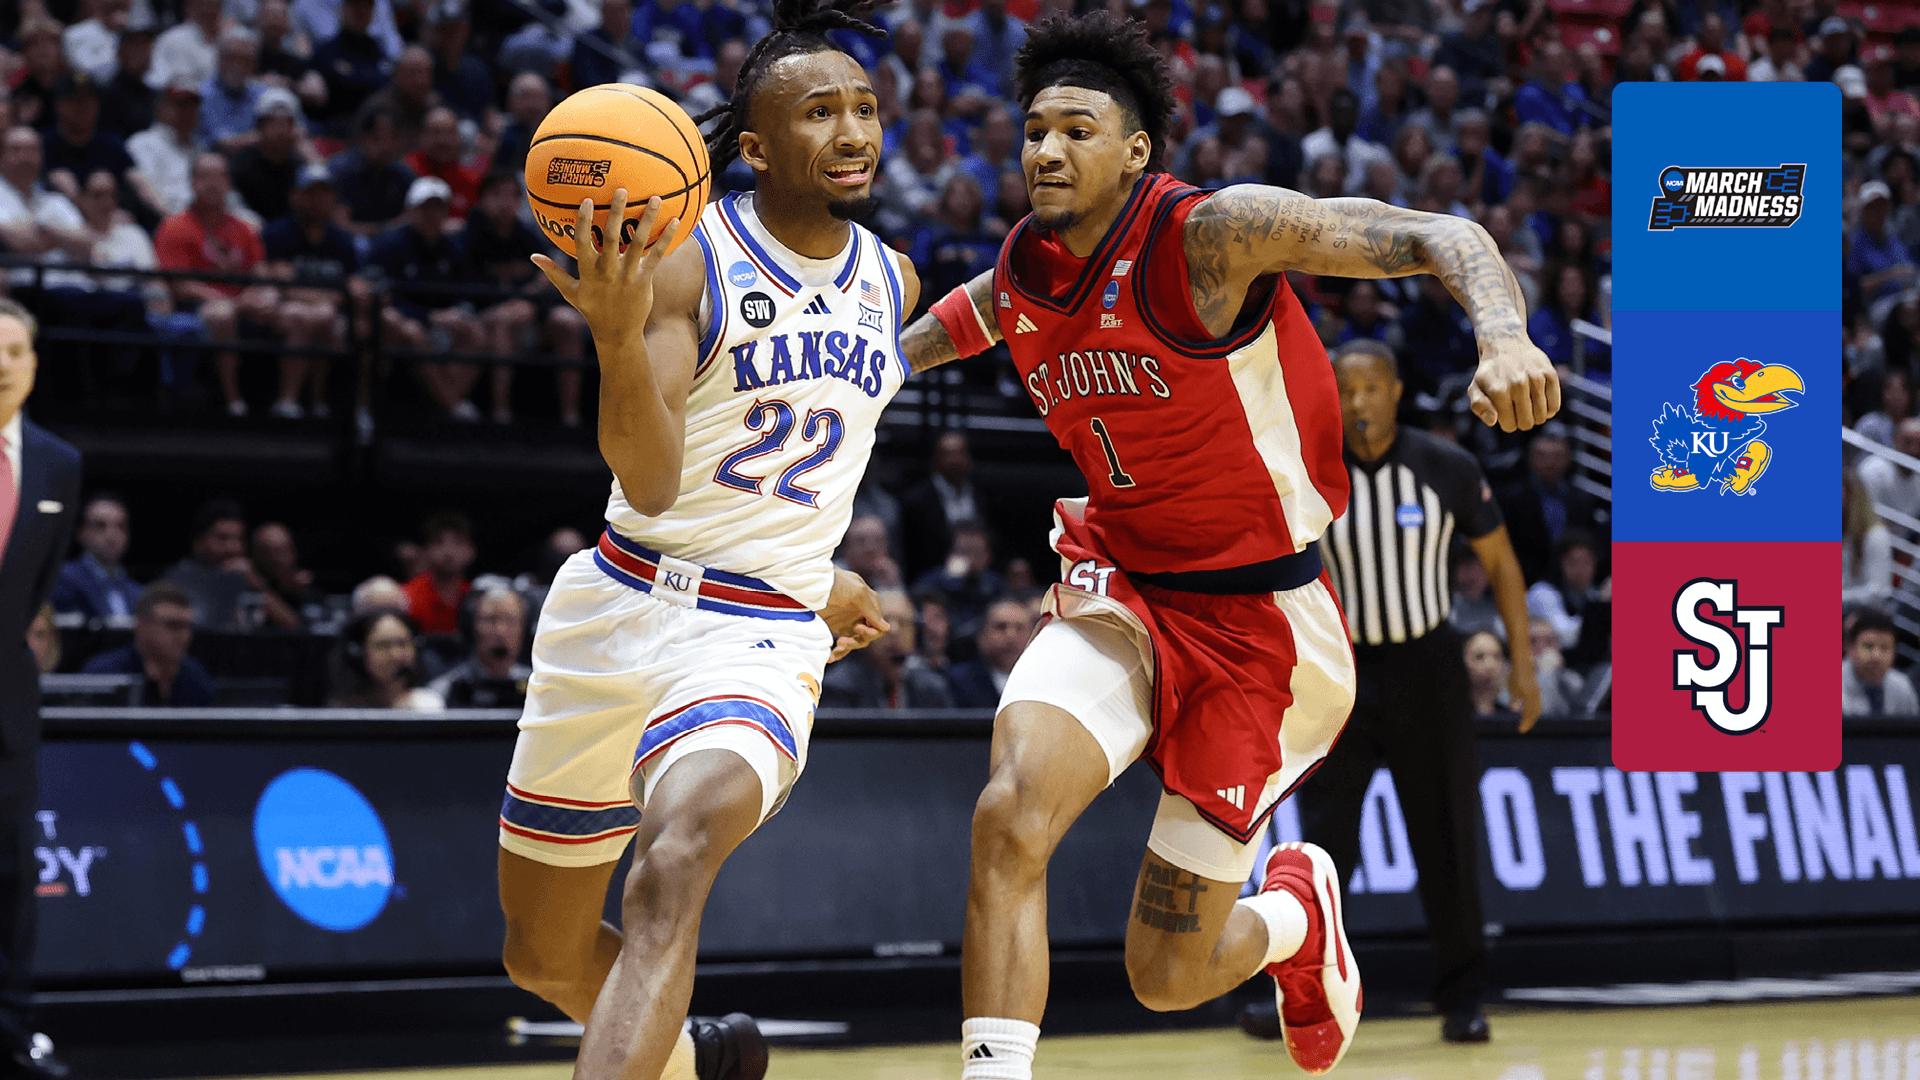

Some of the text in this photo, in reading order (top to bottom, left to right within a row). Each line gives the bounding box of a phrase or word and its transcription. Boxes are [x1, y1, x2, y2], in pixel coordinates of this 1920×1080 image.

[549, 161, 591, 174] MADNESS
[560, 172, 594, 185] MARCH
[1271, 218, 1289, 241] One
[733, 270, 756, 283] NCAA
[744, 300, 771, 320] SW
[728, 331, 886, 397] KANSAS
[1027, 351, 1171, 417] ST. JOHN'S
[713, 398, 845, 510] 22
[1090, 417, 1136, 488] 1
[664, 571, 692, 592] KU
[1550, 765, 1716, 888] THE
[1718, 764, 1920, 885] FINAL
[275, 846, 395, 889] NCAA
